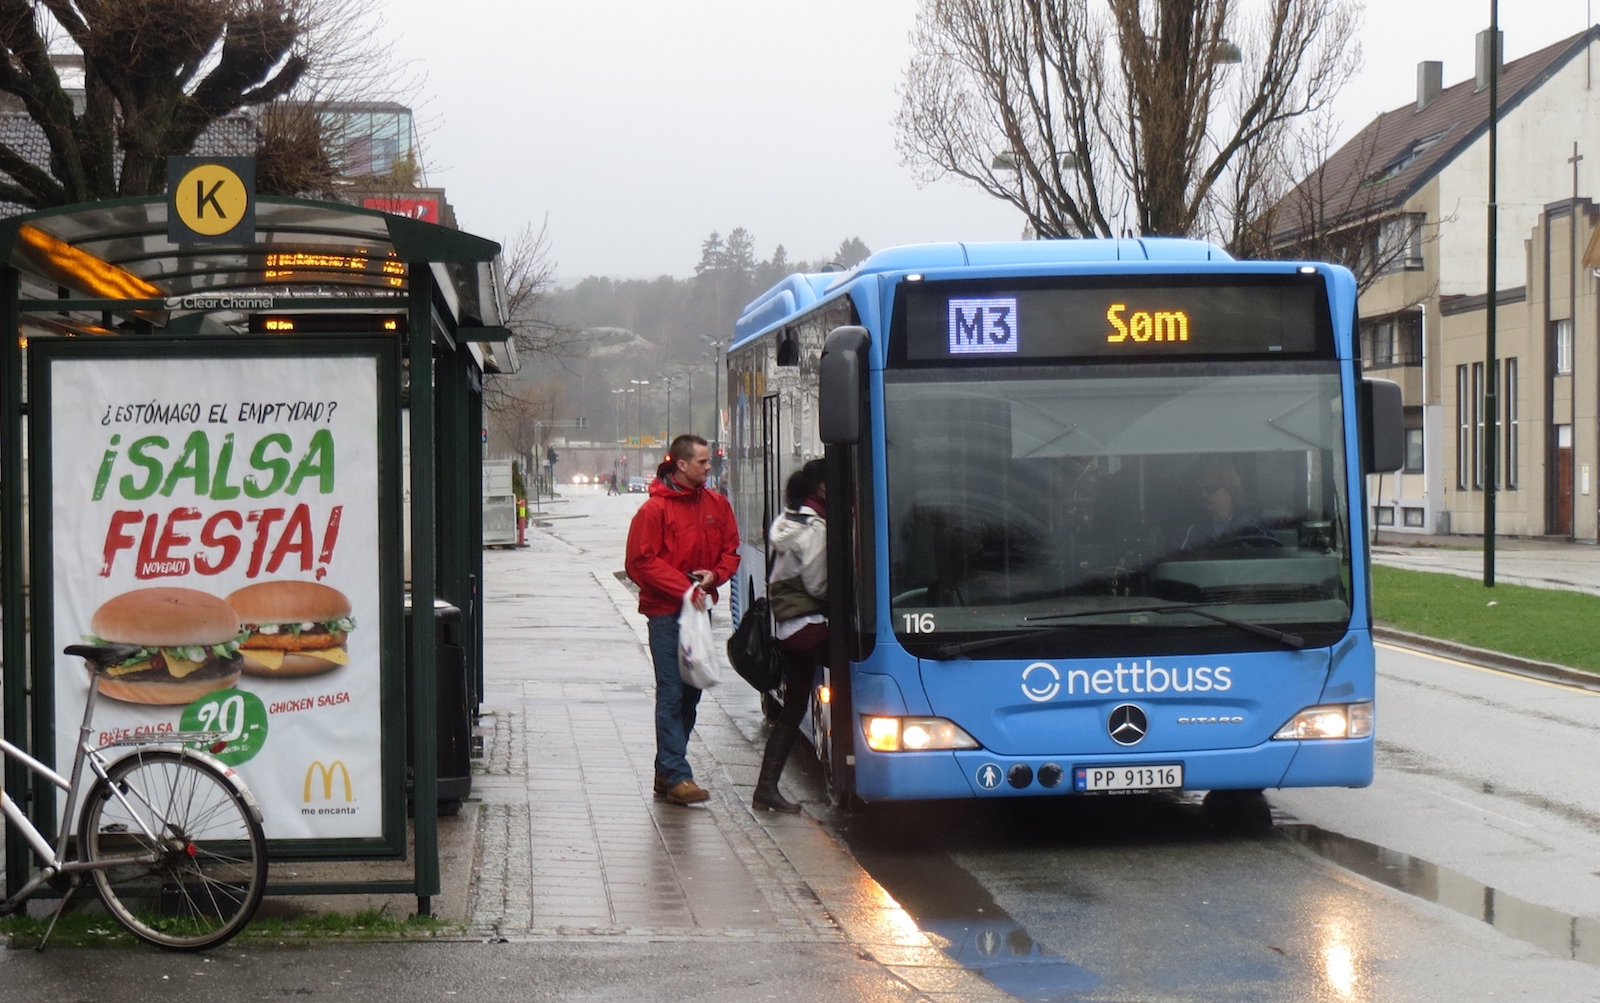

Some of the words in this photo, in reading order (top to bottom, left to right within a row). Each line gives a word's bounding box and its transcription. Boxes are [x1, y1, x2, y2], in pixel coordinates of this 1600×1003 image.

[197, 180, 227, 219] K
[183, 297, 218, 309] Clear
[220, 297, 274, 309] Channel
[955, 307, 1012, 345] M3
[1107, 304, 1188, 342] Søm
[101, 399, 201, 426] ¿ESTÓMAGO
[208, 403, 229, 424] EL
[238, 401, 338, 424] EMPTYDAD?
[91, 428, 335, 501] ¡SALSA
[98, 503, 344, 581] FIESTA!
[142, 561, 187, 576] NOVEDAD!
[902, 612, 936, 635] 116
[1067, 659, 1232, 694] nettbuss
[269, 697, 315, 715] CHICKEN
[318, 692, 350, 707] SALSA
[1177, 716, 1244, 725] CITARO
[1094, 770, 1115, 787] PP
[1125, 768, 1175, 787] 91316
[301, 807, 316, 815] me
[318, 806, 356, 815] encanta
